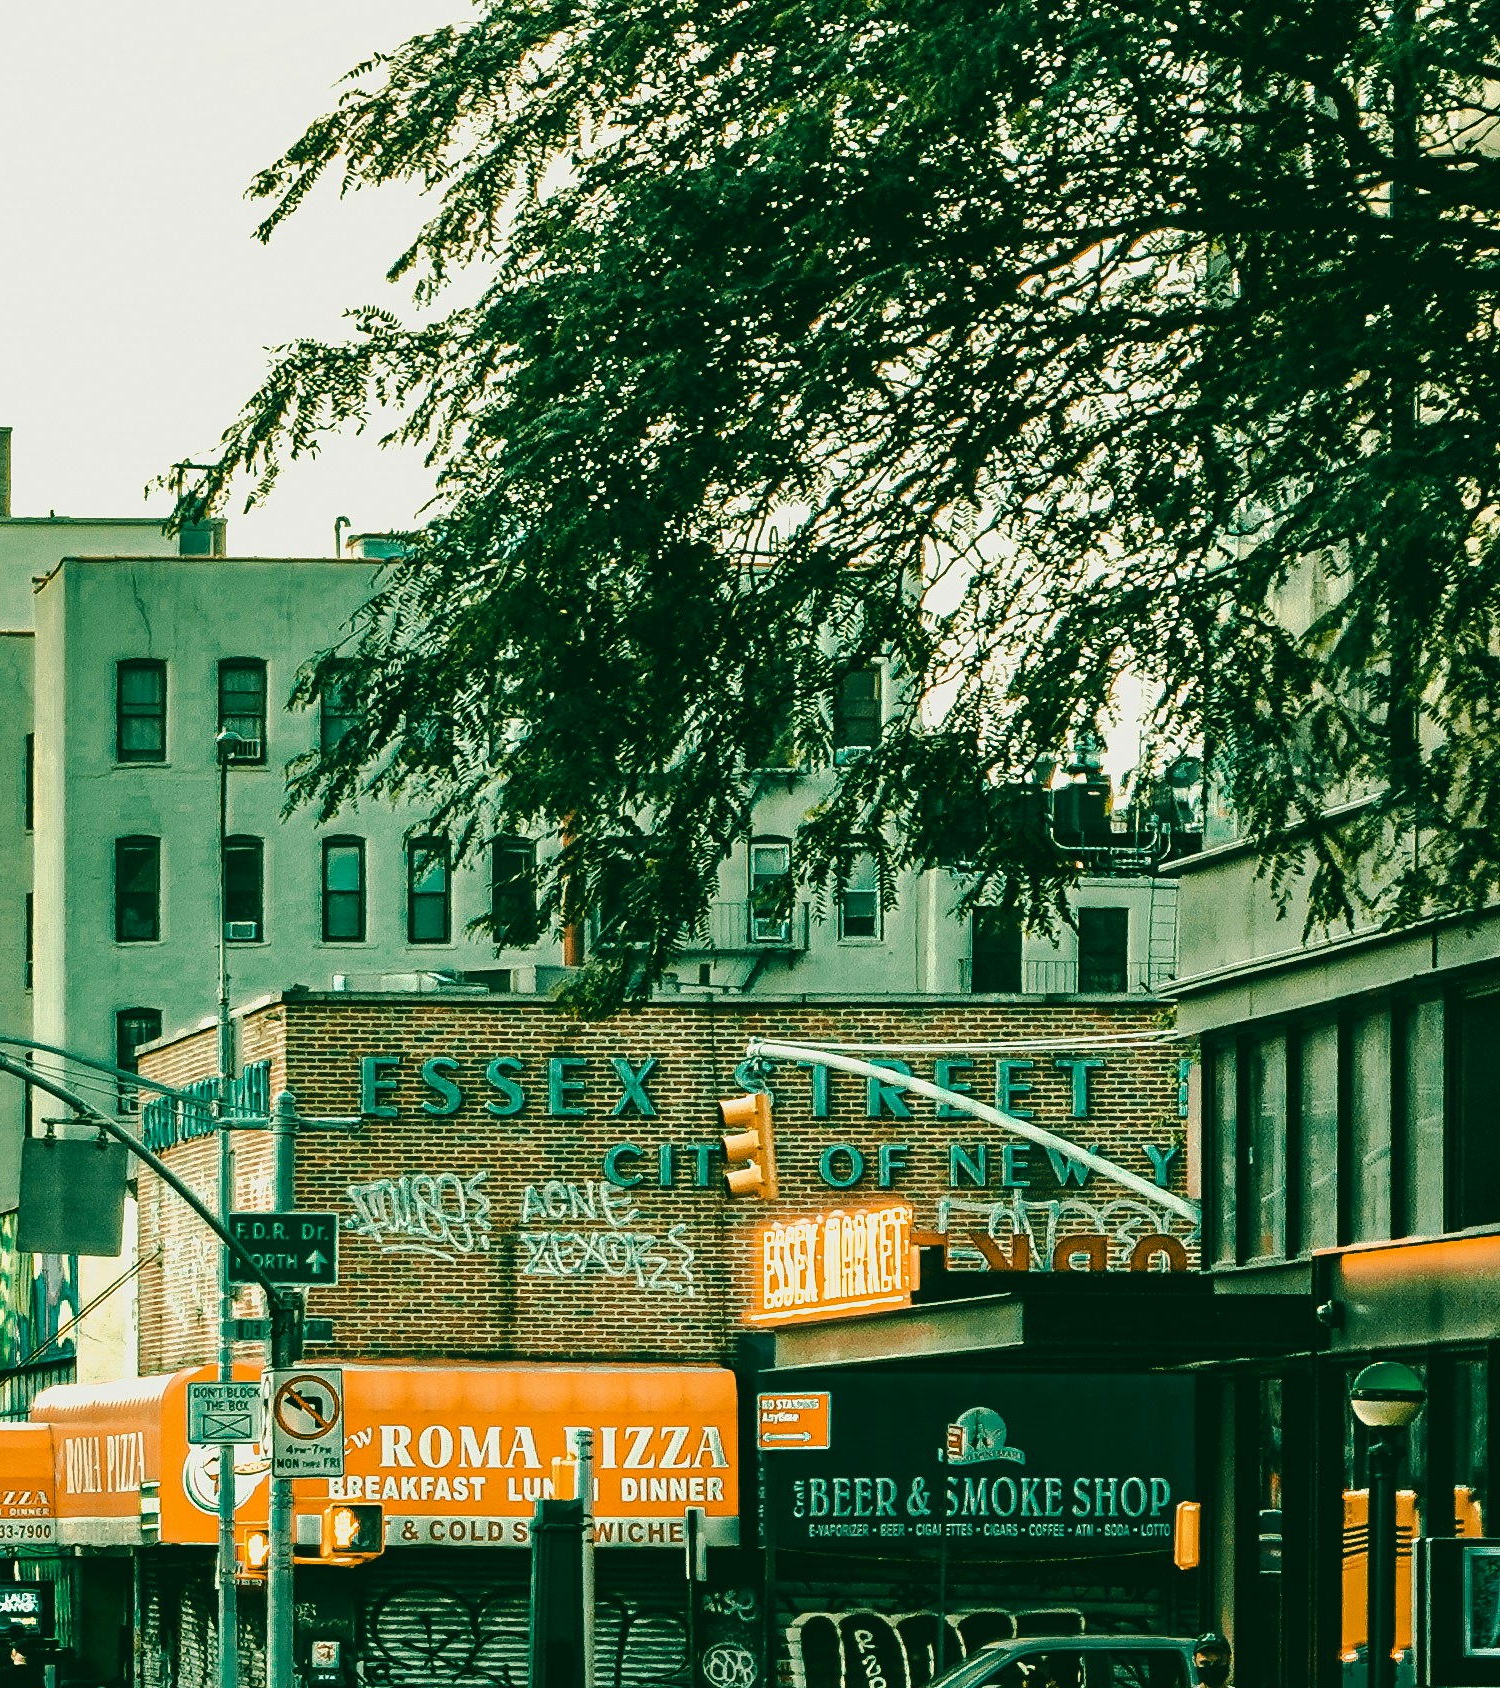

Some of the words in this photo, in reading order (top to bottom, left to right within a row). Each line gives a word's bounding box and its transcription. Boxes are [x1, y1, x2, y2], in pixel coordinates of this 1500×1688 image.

[361, 1057, 657, 1116] ESSEX
[735, 1058, 1105, 1118] STREET
[603, 1143, 722, 1187] CIT
[818, 1143, 908, 1188] OF
[949, 1144, 1099, 1188] NEW
[235, 1223, 290, 1241] F.D.R.
[301, 1223, 329, 1241] Dr.
[762, 1222, 820, 1311] ESSEX
[822, 1207, 909, 1302] MARKET
[226, 1387, 261, 1399] BLOCK
[761, 1399, 775, 1410] NO
[205, 1400, 226, 1412] THE
[228, 1400, 250, 1412] BOX
[379, 1424, 542, 1469] ROMA
[65, 1436, 102, 1494] ROMA
[106, 1431, 145, 1493] PIZZA
[276, 1458, 300, 1469] MON
[323, 1457, 341, 1468] FRI
[328, 1475, 486, 1501] BREAKFAST
[621, 1476, 724, 1501] DINNER
[809, 1477, 898, 1517] BEER
[906, 1476, 932, 1516] &
[946, 1476, 1064, 1517] SMOKE
[1072, 1476, 1171, 1518] SHOP
[9, 1507, 50, 1517] DINNER
[401, 1520, 420, 1541] &
[429, 1519, 500, 1542] COLD
[879, 1523, 906, 1537] BEER
[983, 1523, 1019, 1537] CIGARS
[1028, 1523, 1065, 1537] COFFEE
[1074, 1523, 1094, 1537] ATM
[1104, 1523, 1130, 1537] SODA
[1141, 1523, 1171, 1537] LOTTO
